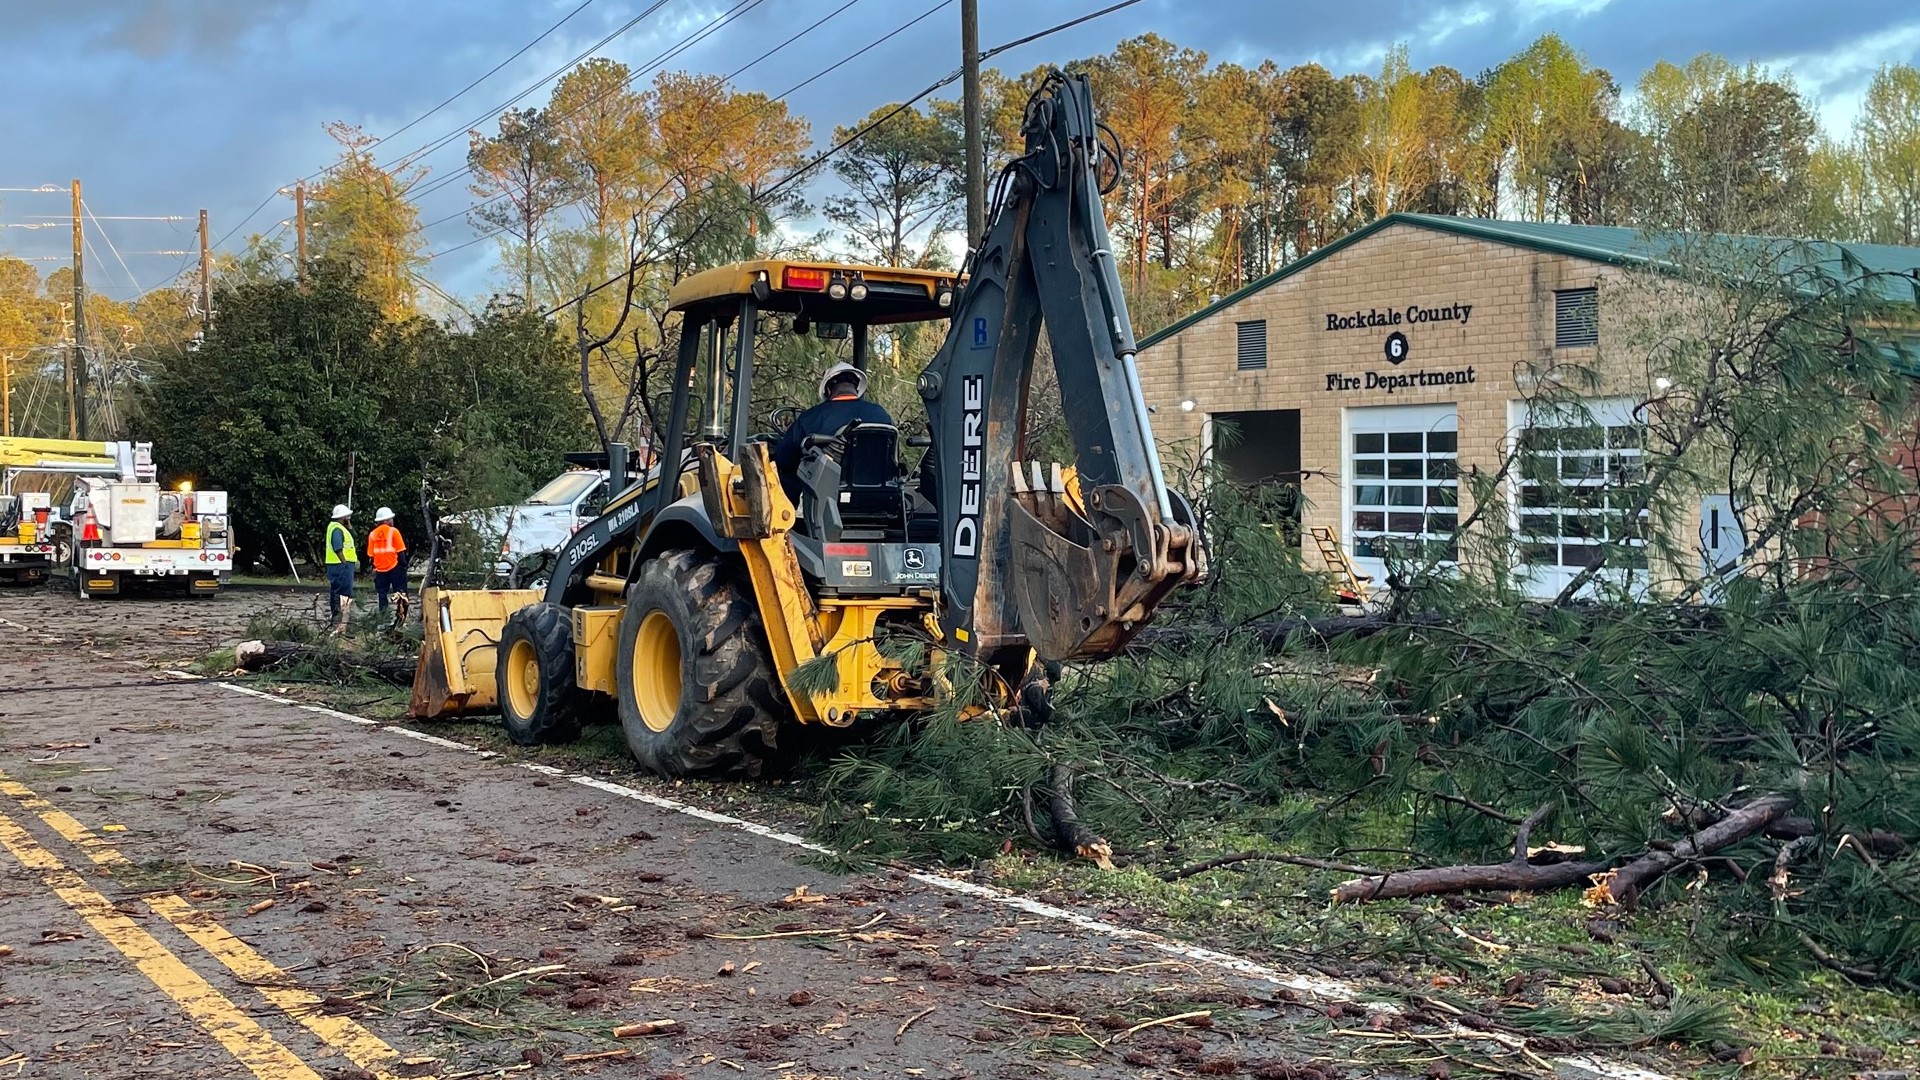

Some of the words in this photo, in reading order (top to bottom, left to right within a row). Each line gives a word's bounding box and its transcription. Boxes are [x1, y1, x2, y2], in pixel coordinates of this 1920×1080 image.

[1325, 308, 1401, 331] Rockdale
[1406, 302, 1473, 324] County
[1390, 338, 1402, 357] 6
[1325, 373, 1361, 391] Fire
[1364, 365, 1475, 394] Department
[953, 378, 983, 557] DEERE
[569, 533, 599, 565] 310SL
[895, 572, 914, 580] JOHN
